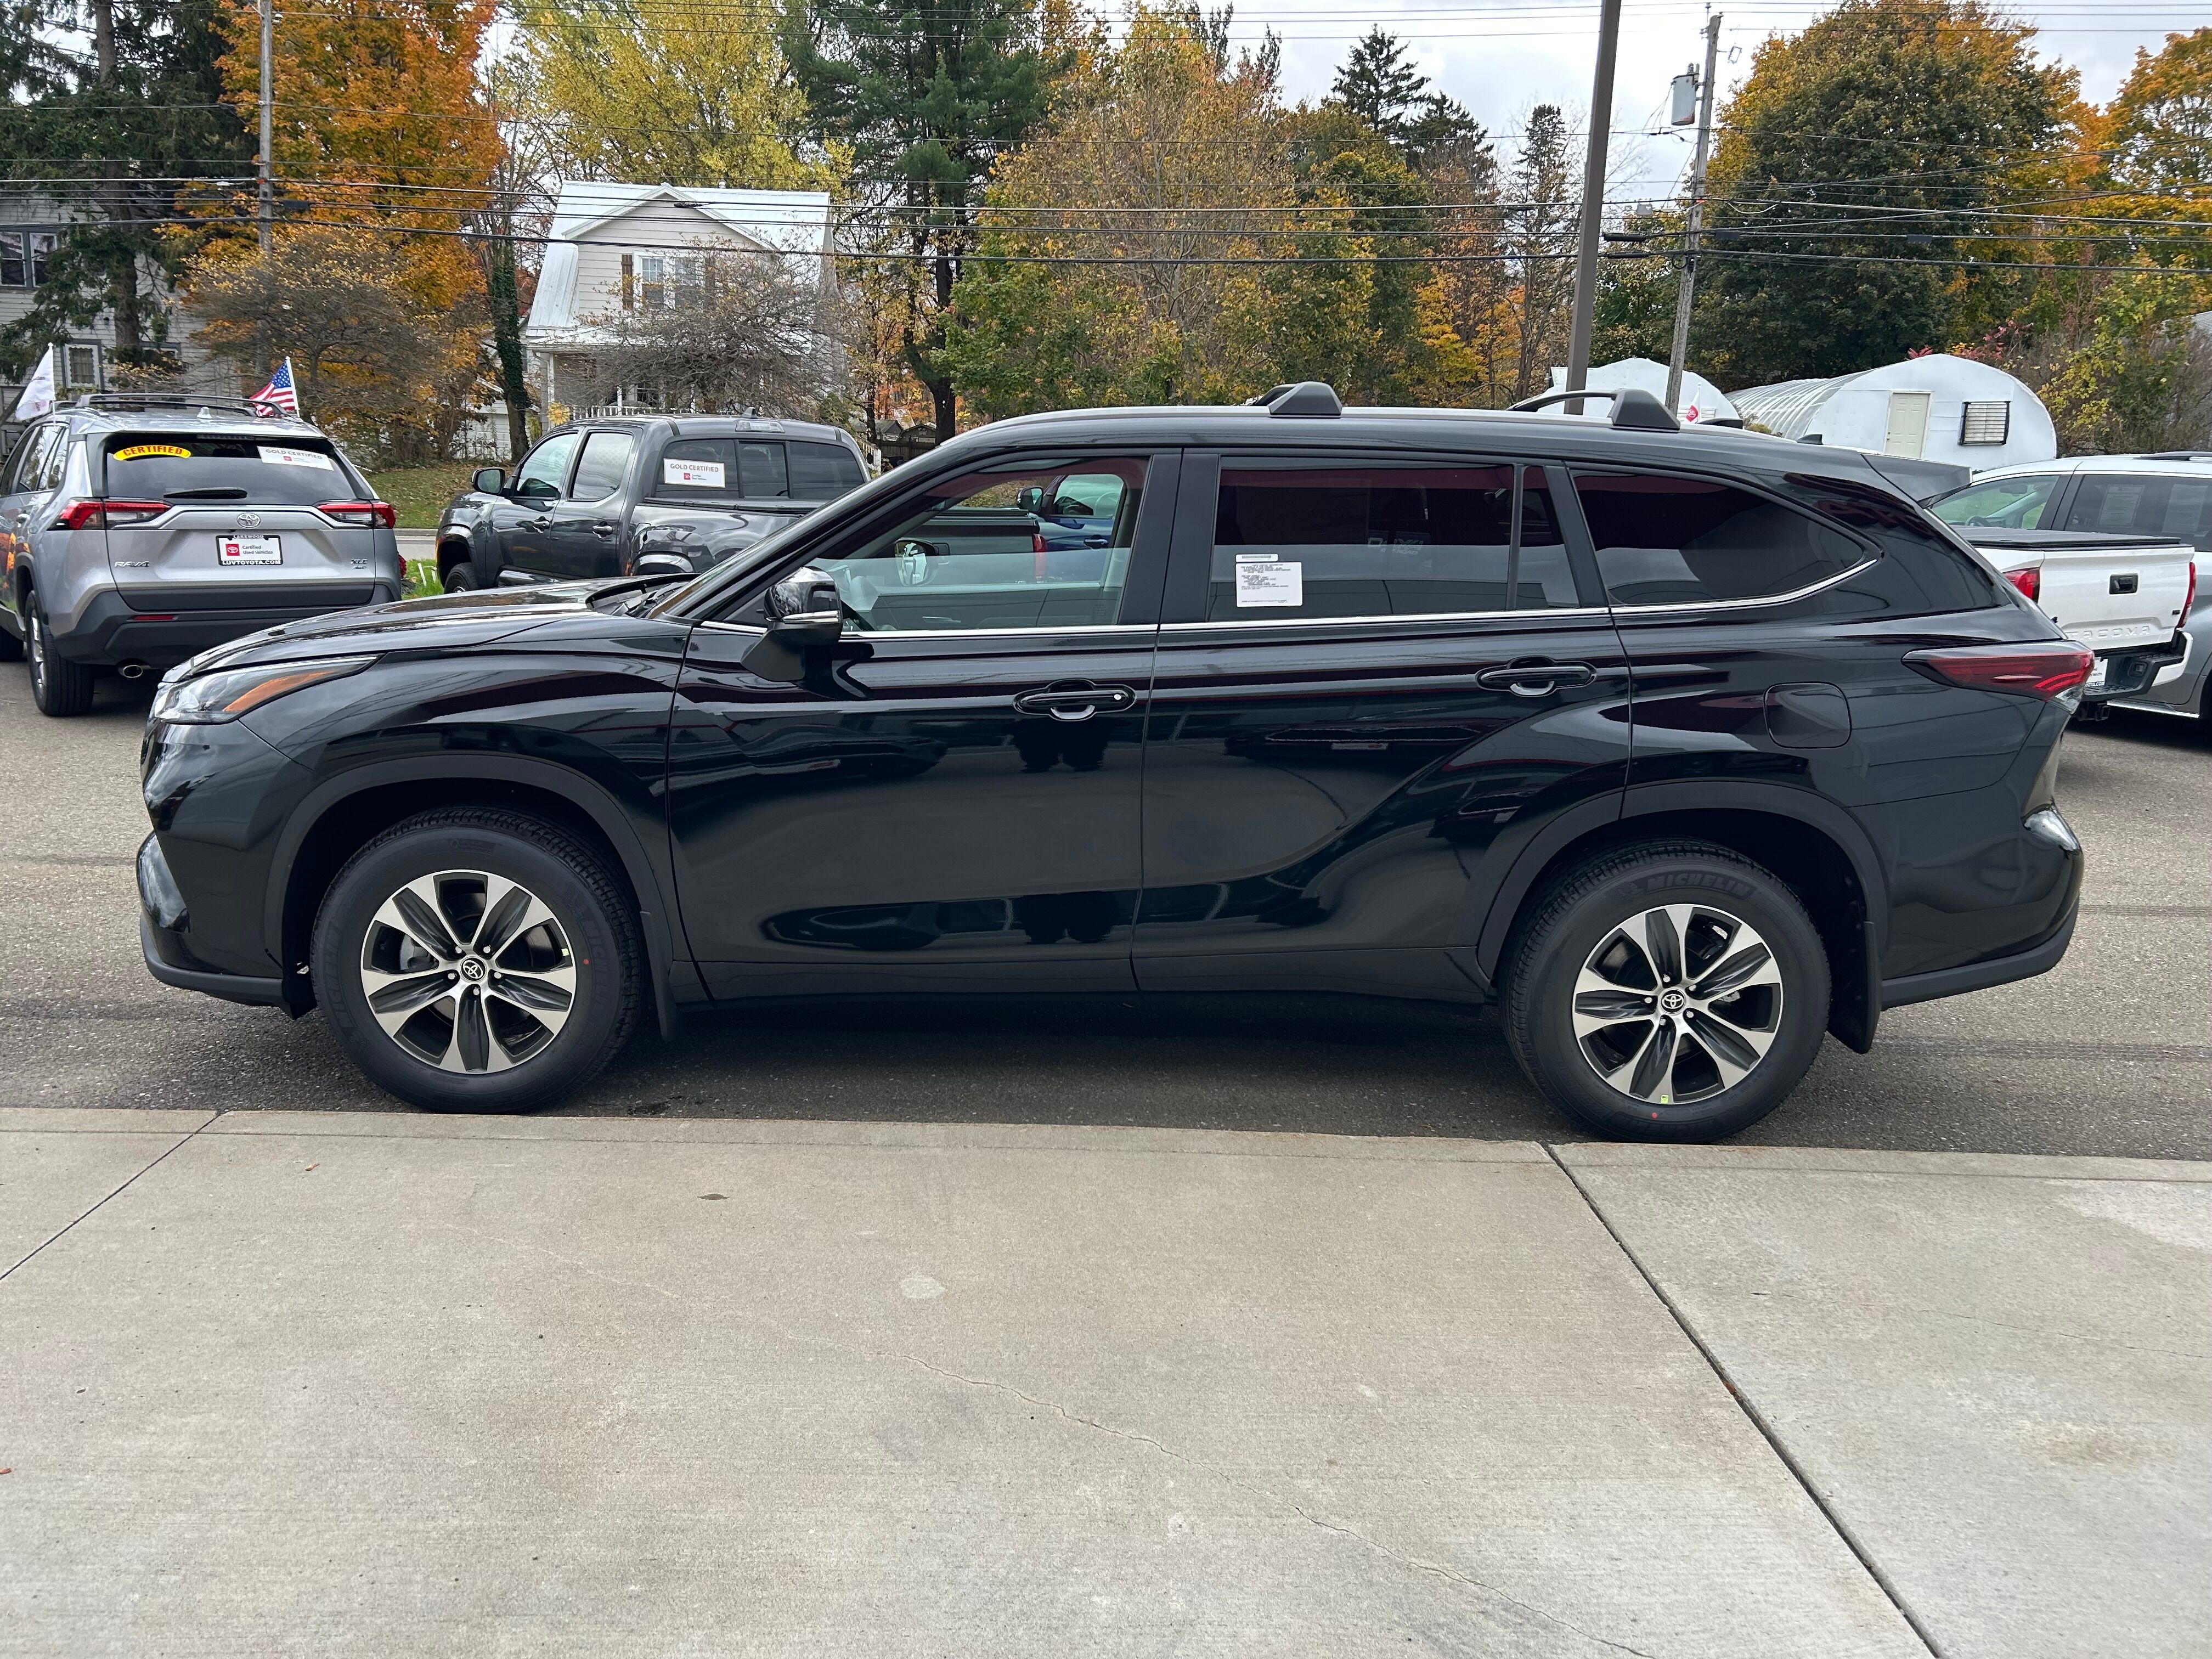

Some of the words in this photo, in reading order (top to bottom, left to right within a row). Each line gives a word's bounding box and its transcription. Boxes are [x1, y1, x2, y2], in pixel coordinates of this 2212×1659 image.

[122, 445, 183, 456] CERTIFIED
[288, 451, 323, 459] CERTIFIED
[2064, 625, 2151, 640] TACOMA
[1647, 873, 1751, 896] MICHELIN
